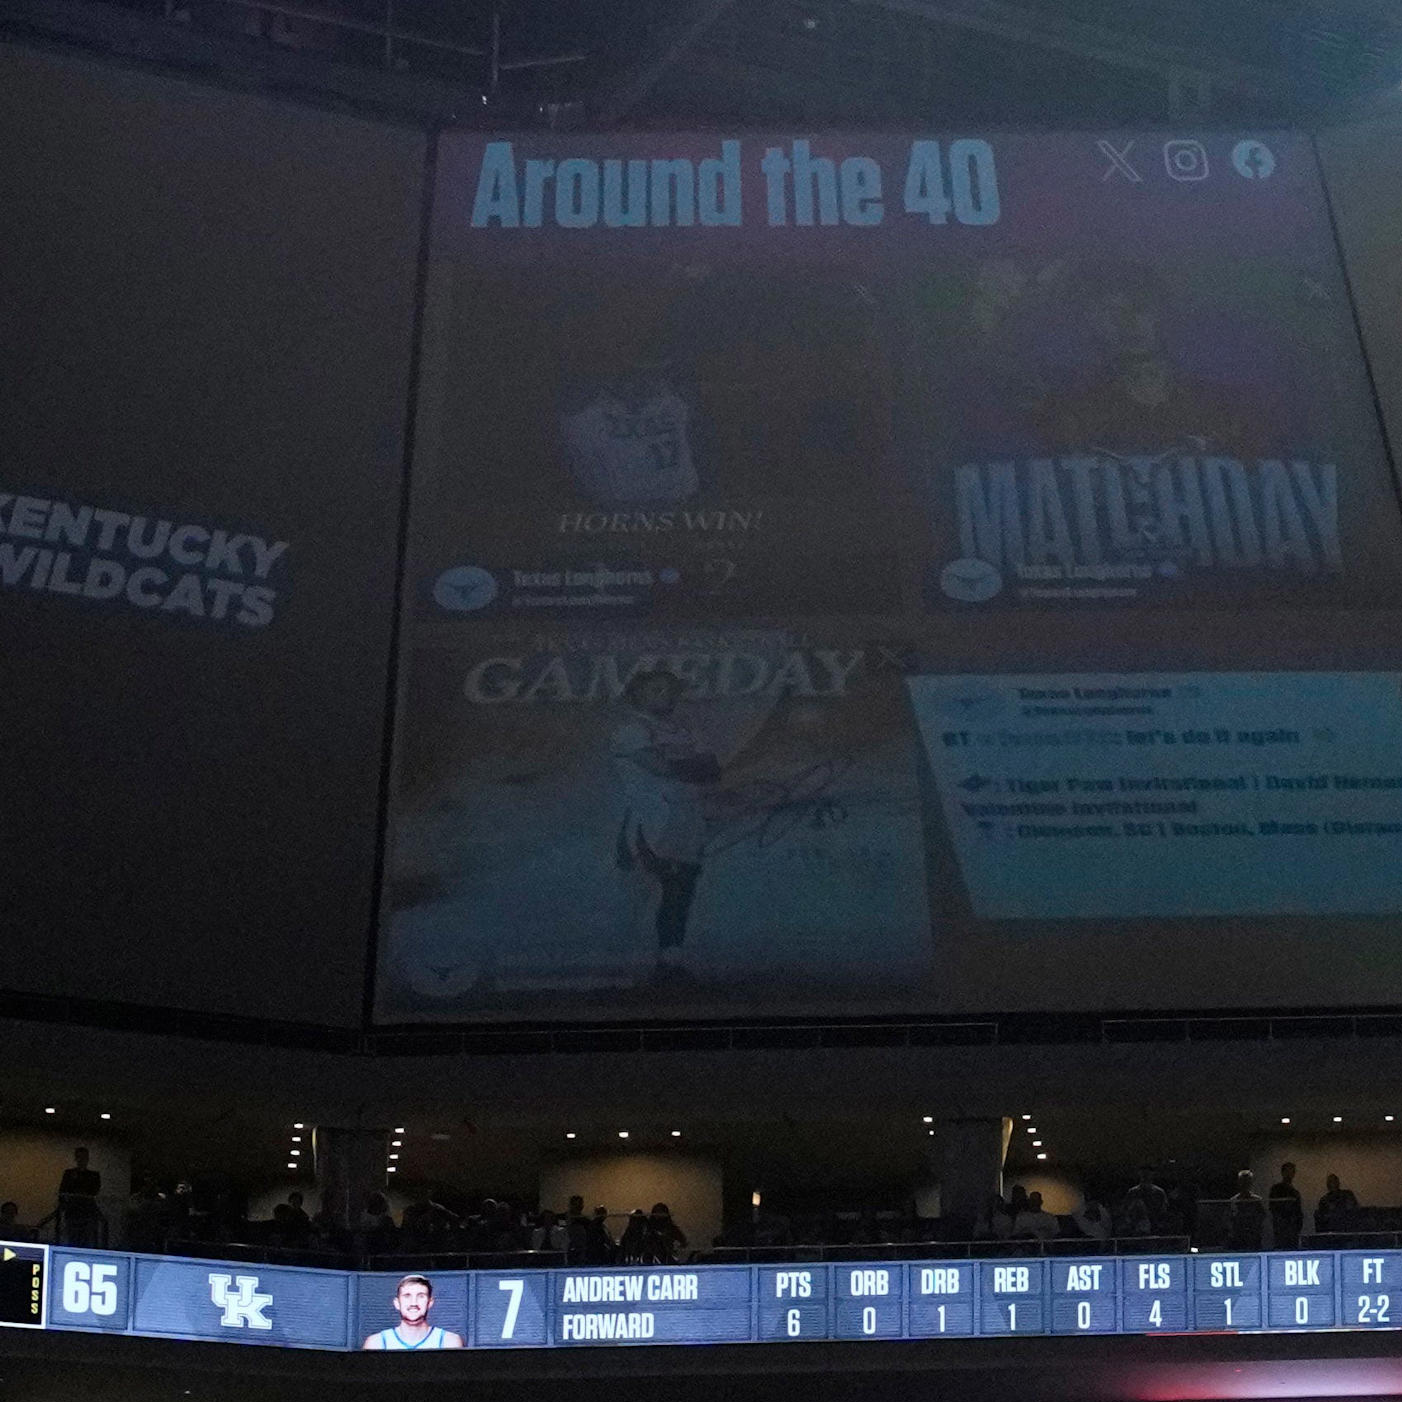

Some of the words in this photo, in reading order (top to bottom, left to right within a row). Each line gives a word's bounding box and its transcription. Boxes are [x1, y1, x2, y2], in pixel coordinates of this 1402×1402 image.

[471, 141, 741, 228] Around
[760, 141, 884, 228] the
[903, 139, 1001, 226] 40
[63, 1261, 117, 1316] 65
[563, 1275, 643, 1302] ANDREW
[647, 1275, 698, 1300] CARR
[776, 1272, 811, 1298] PTS
[850, 1270, 888, 1296] ORB
[921, 1268, 960, 1295] DRB
[994, 1267, 1029, 1293] REB
[1067, 1265, 1102, 1291] AST
[1139, 1263, 1171, 1290] FLS
[1211, 1262, 1244, 1288] STL
[1284, 1260, 1320, 1286] BLK
[1363, 1258, 1384, 1284] FT
[499, 1280, 524, 1339] 7
[563, 1313, 654, 1340] FORWARD
[787, 1310, 800, 1336] 6
[863, 1308, 876, 1335] 0
[938, 1306, 946, 1332] 1
[1008, 1304, 1016, 1331] 1
[1077, 1302, 1091, 1329] 0
[1150, 1301, 1162, 1327] 4
[1224, 1299, 1232, 1326] 1
[1295, 1298, 1308, 1324] 0
[1358, 1296, 1390, 1322] 2-2
